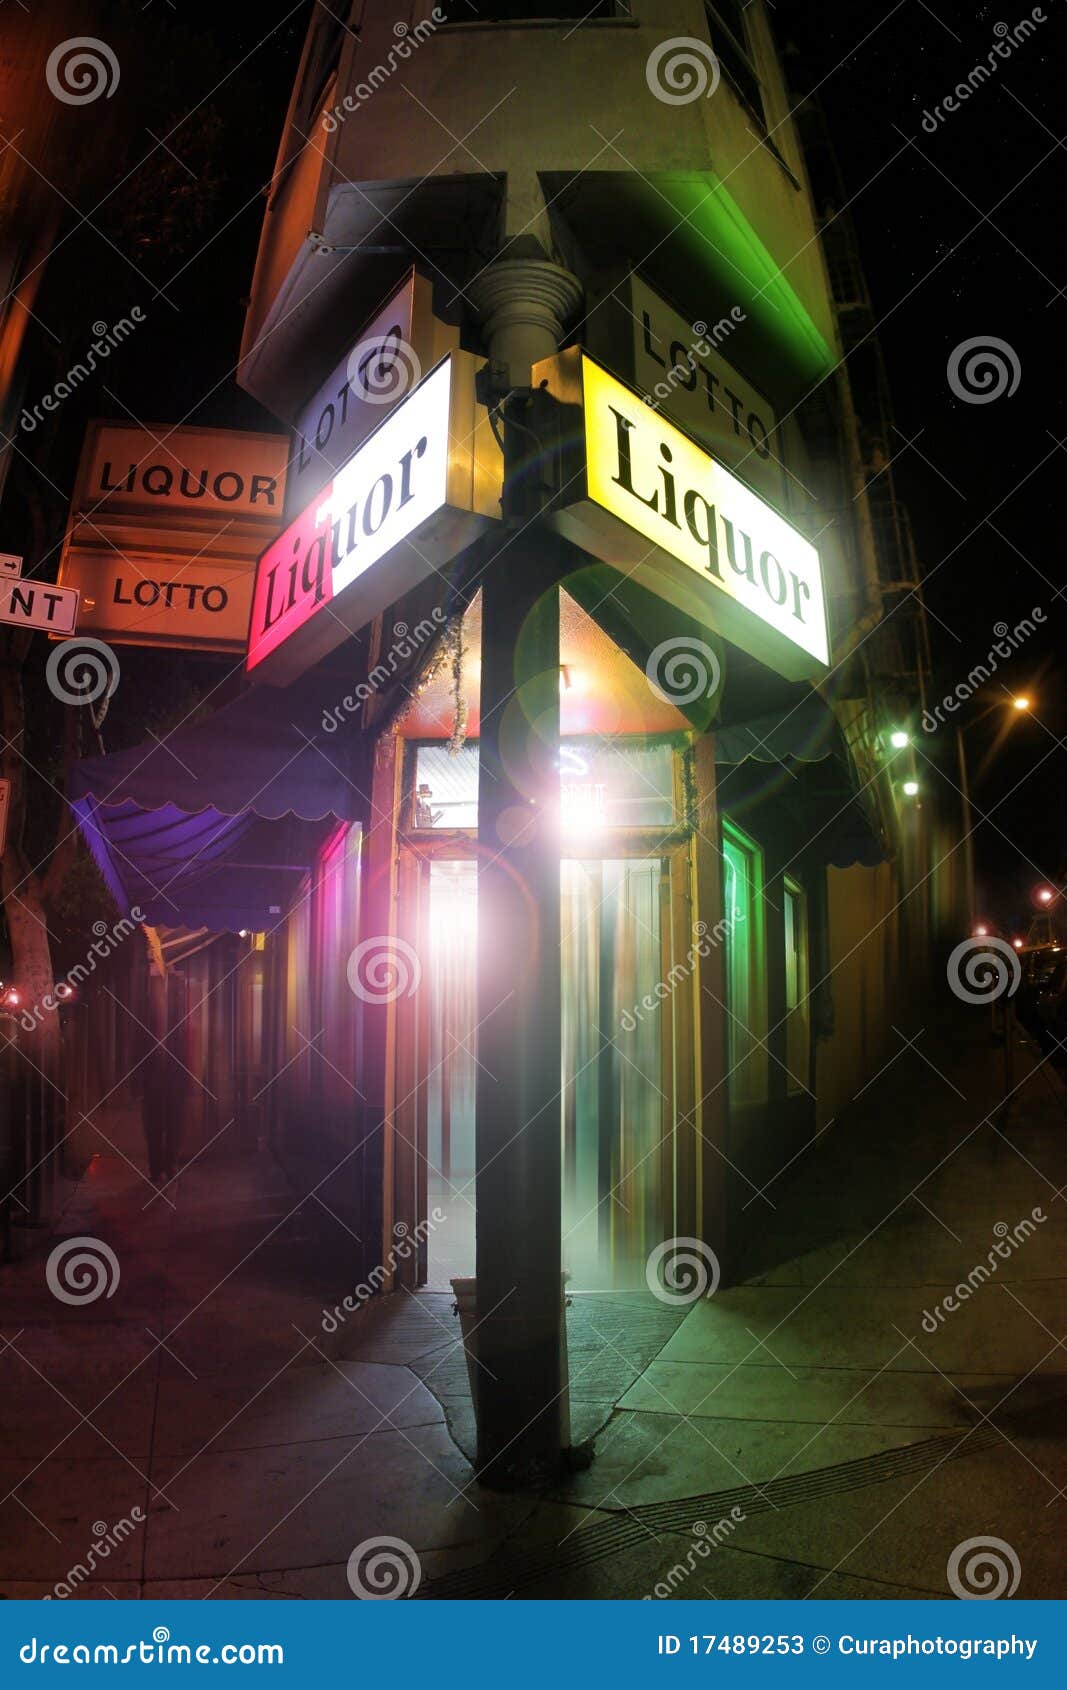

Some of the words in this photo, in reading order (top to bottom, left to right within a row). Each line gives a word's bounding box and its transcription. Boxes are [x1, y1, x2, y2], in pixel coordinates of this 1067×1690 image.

[296, 324, 403, 474] LOTTO
[643, 310, 771, 460] LOTTO
[100, 462, 278, 505] LIQUOR
[261, 435, 428, 636] Liquor
[608, 404, 810, 624] Liquor
[112, 578, 228, 612] LOTTO
